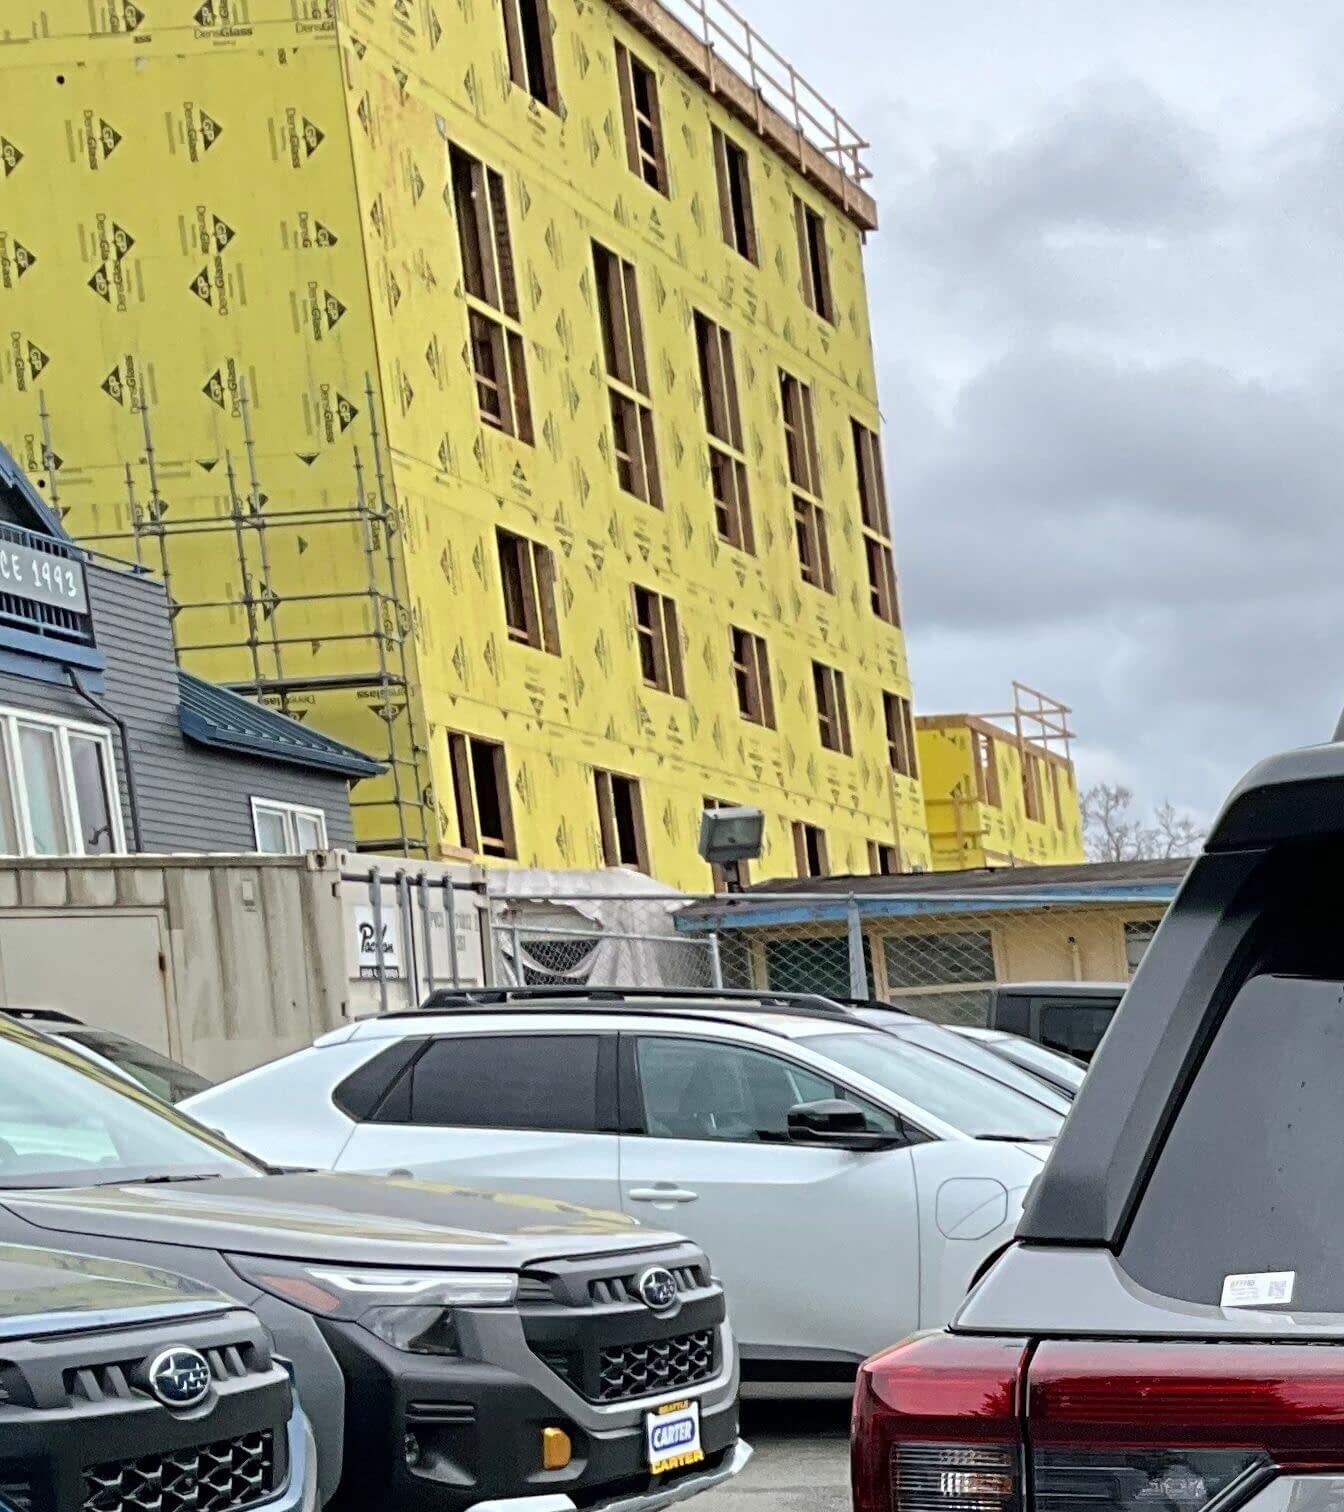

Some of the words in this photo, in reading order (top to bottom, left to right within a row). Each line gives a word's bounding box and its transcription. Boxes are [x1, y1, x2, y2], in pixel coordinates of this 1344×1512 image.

[32, 559, 77, 597] 1993
[653, 1420, 692, 1449] CARTER
[652, 1449, 704, 1474] CARTER
